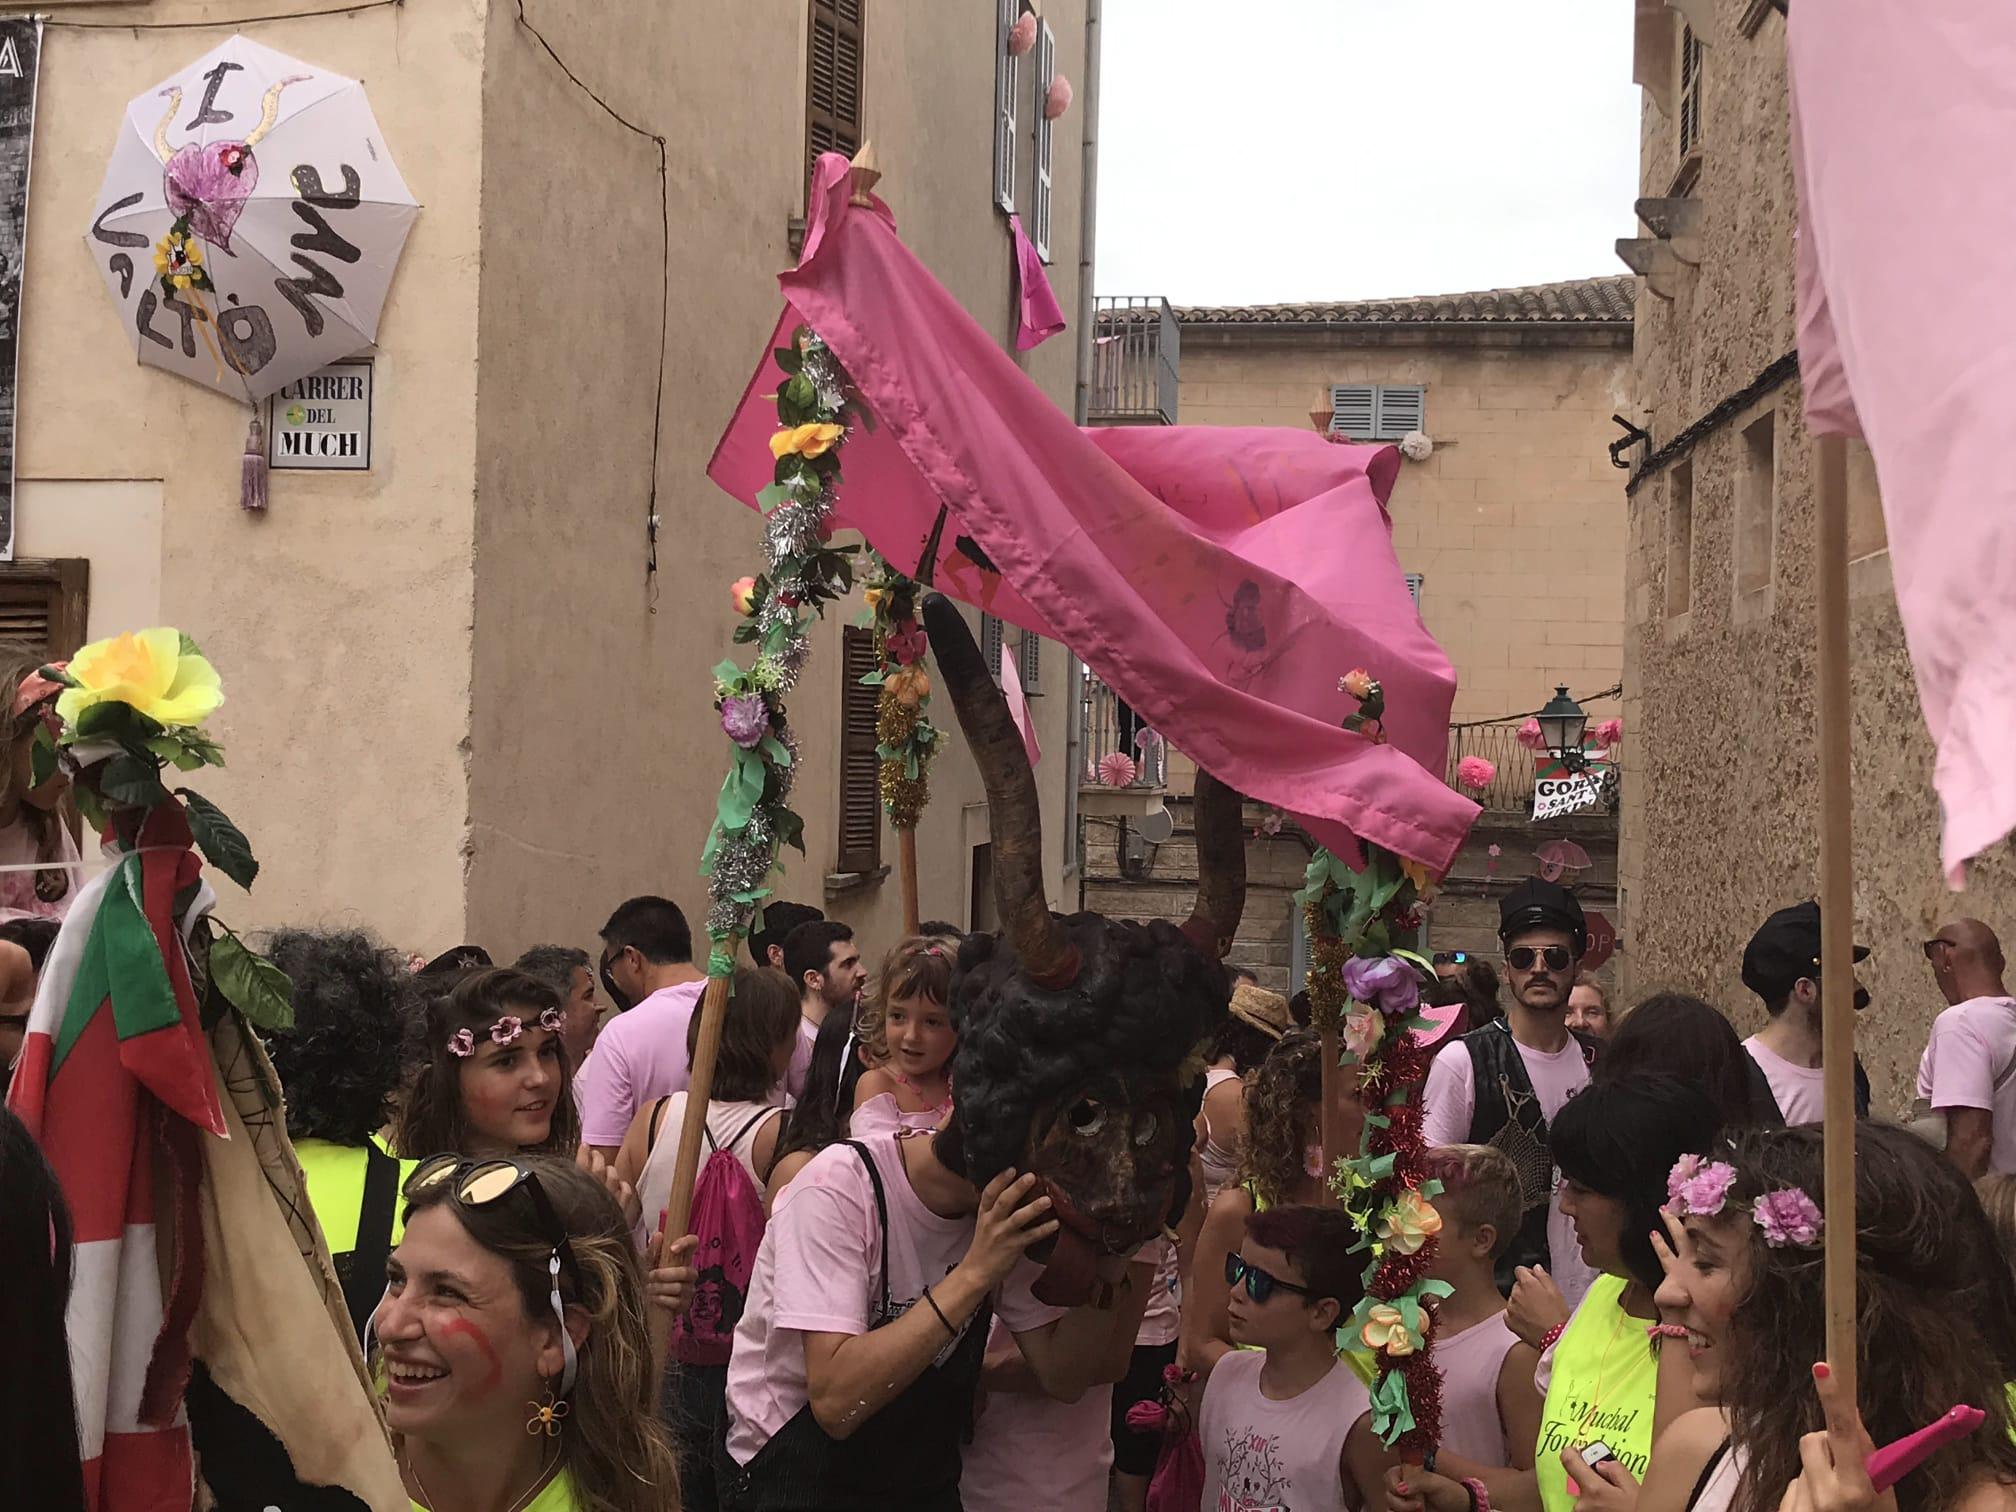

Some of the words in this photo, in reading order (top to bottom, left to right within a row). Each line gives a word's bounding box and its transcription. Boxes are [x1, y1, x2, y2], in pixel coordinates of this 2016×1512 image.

[185, 62, 244, 131] I
[306, 408, 336, 424] DEL
[280, 432, 358, 456] MUCH
